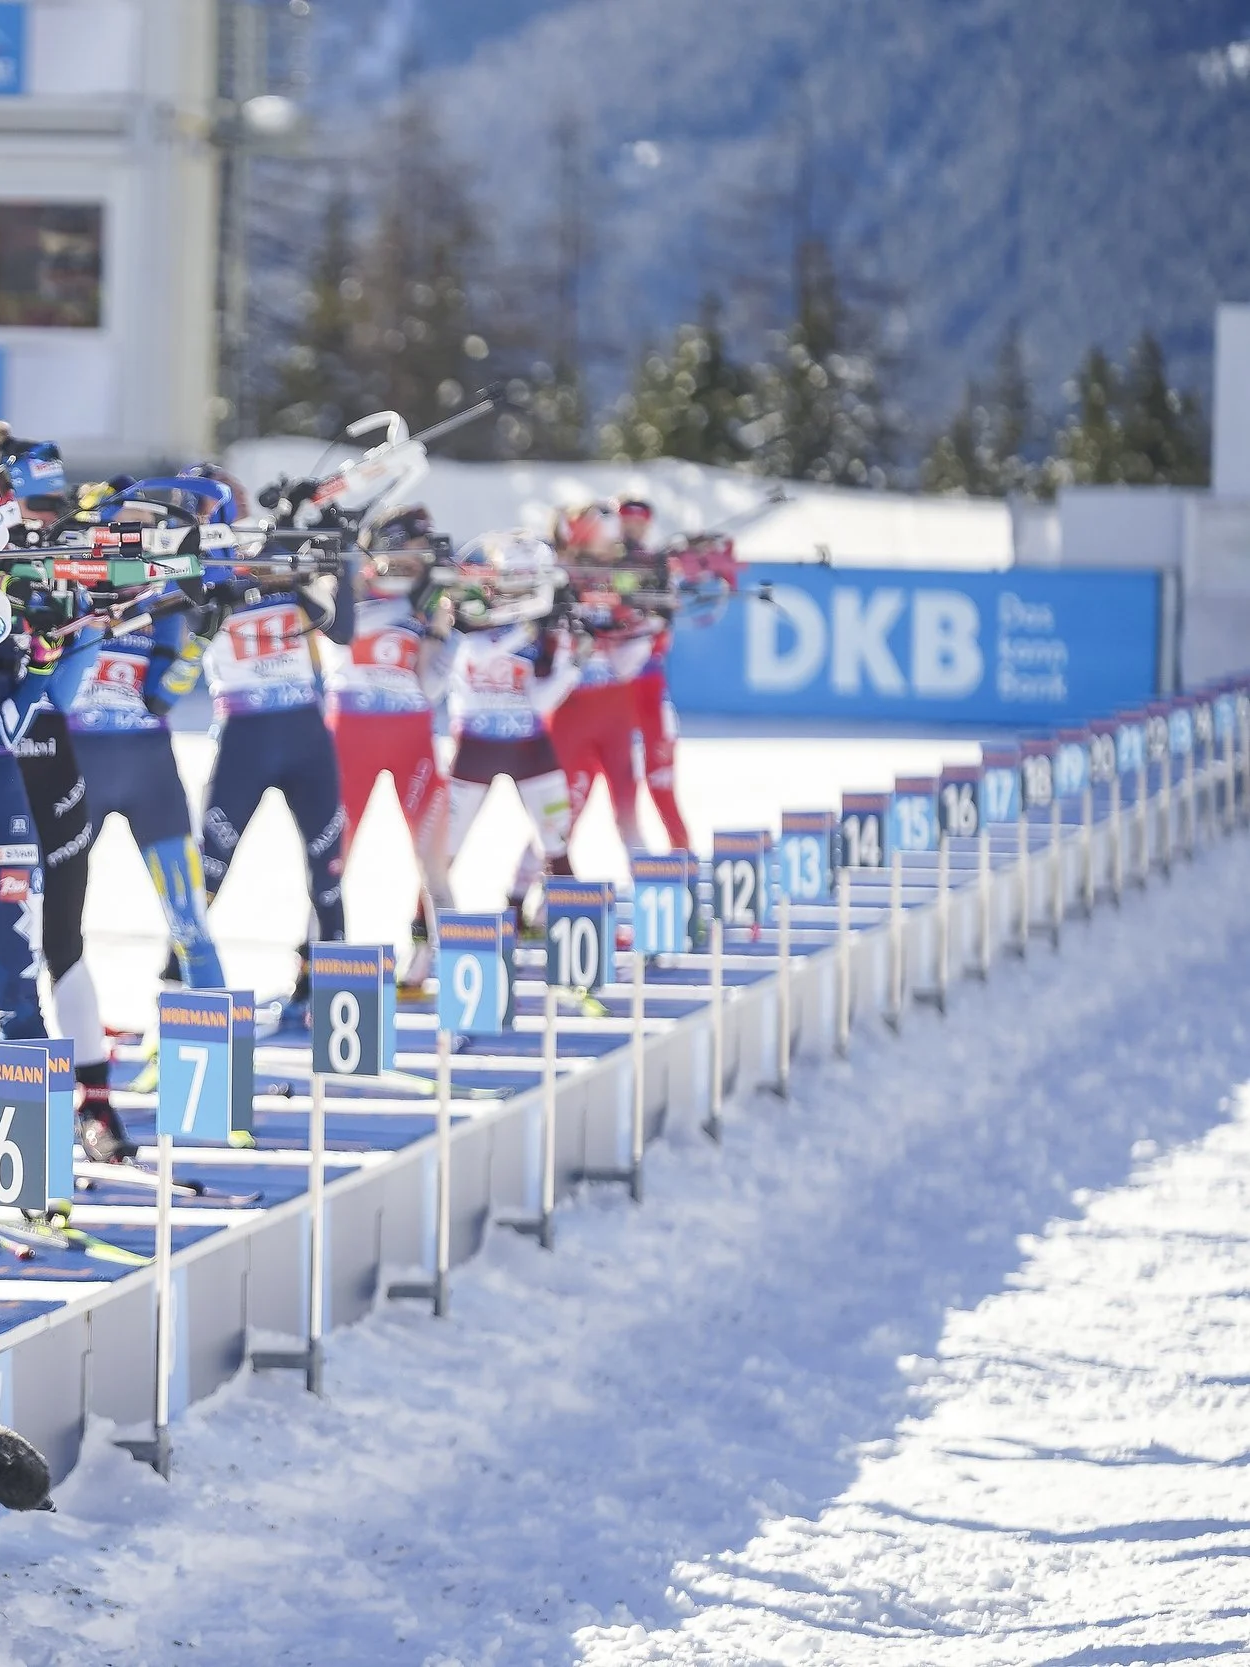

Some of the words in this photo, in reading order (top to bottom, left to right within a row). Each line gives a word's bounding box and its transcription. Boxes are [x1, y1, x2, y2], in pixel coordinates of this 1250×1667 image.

[748, 583, 983, 696] DKB
[896, 796, 930, 850] 15
[943, 782, 978, 837] 16
[983, 768, 1014, 820] 17
[783, 836, 821, 899] 13
[843, 814, 882, 868] 14
[640, 885, 675, 950] 11
[715, 859, 755, 925] 12
[550, 915, 599, 989] 10
[453, 953, 483, 1031] 9
[328, 990, 361, 1073] 8
[178, 1045, 208, 1134] 7
